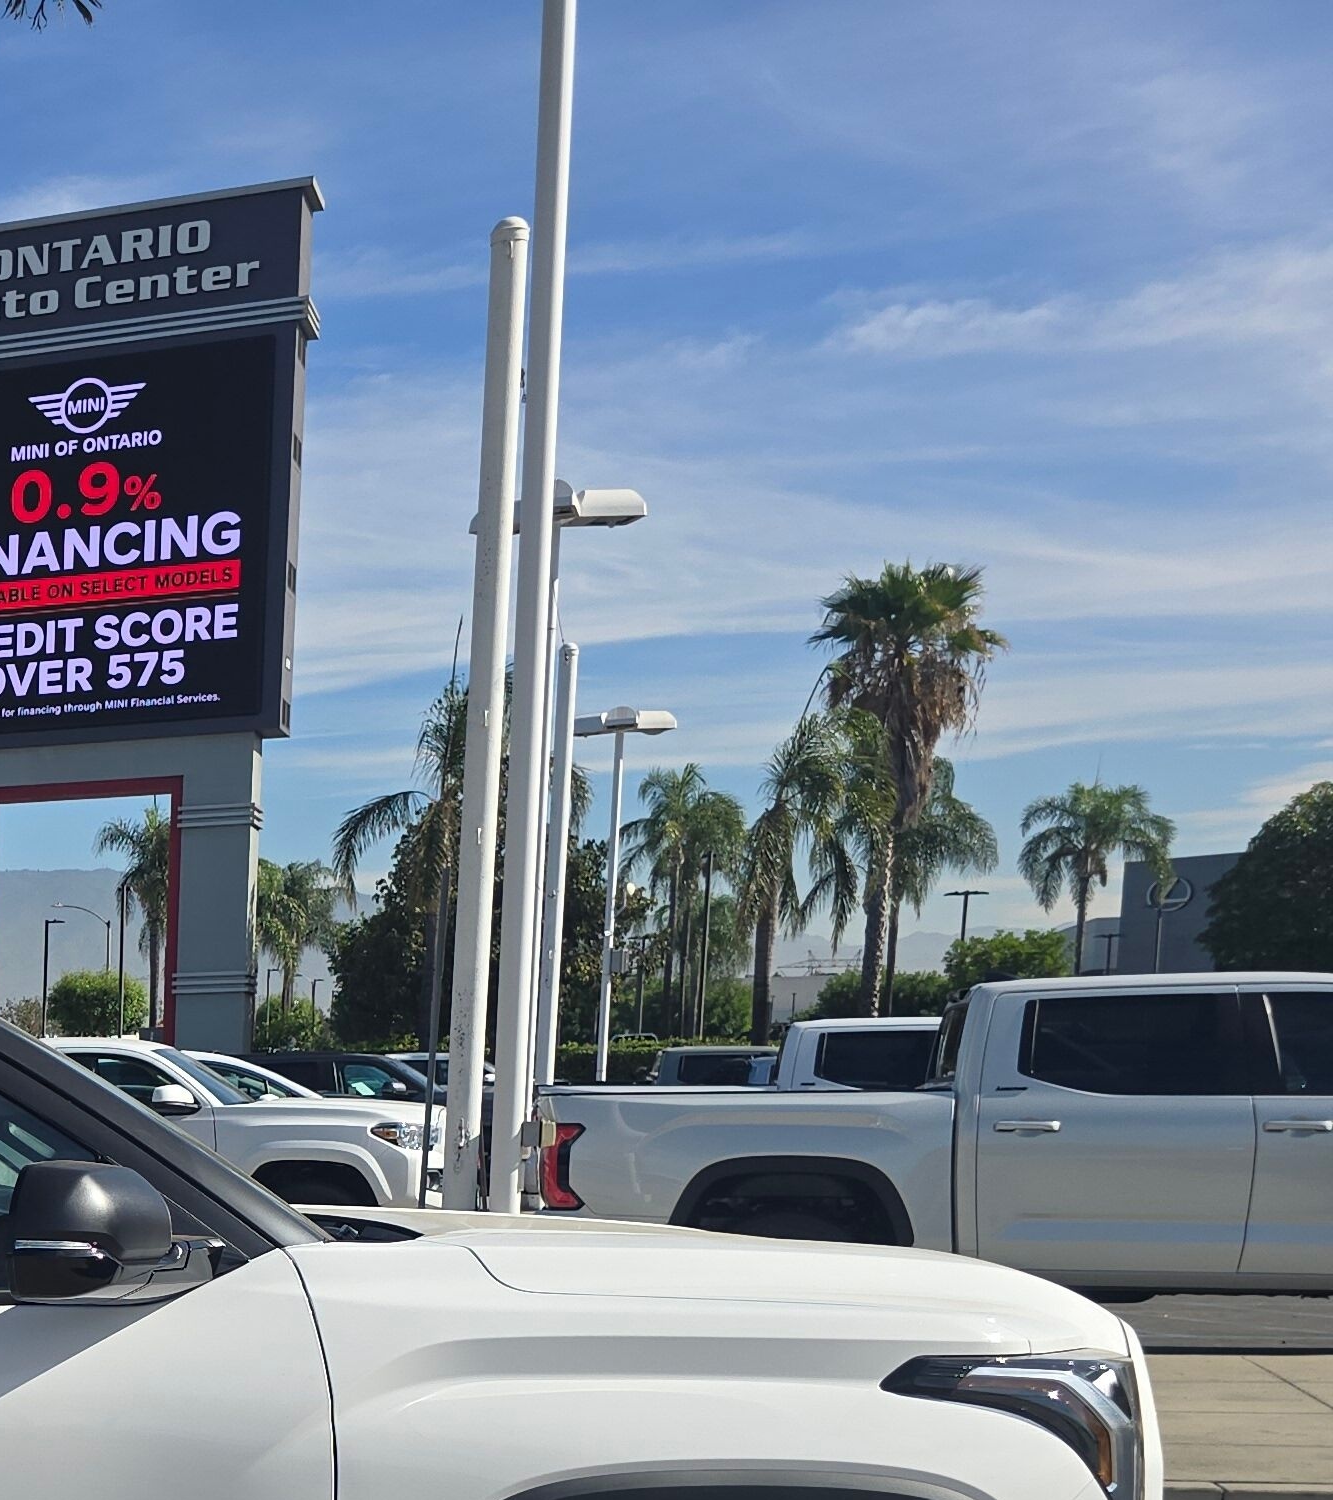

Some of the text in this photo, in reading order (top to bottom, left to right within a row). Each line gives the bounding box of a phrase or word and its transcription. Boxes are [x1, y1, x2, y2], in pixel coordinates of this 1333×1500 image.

[74, 260, 260, 309] Center
[67, 396, 105, 415] MINI
[11, 429, 162, 462] MINI OF ONTARIO
[10, 461, 162, 524] 0.9%
[47, 582, 73, 600] ON
[80, 573, 147, 595] SELECT
[154, 565, 233, 589] MODELS
[93, 603, 240, 651] SCORE
[106, 649, 185, 690] 575
[1, 707, 16, 718] for
[17, 704, 62, 716] financing
[63, 700, 103, 714] through
[104, 698, 129, 710] MINI
[130, 694, 175, 708] Financial
[176, 692, 221, 705] Services.
